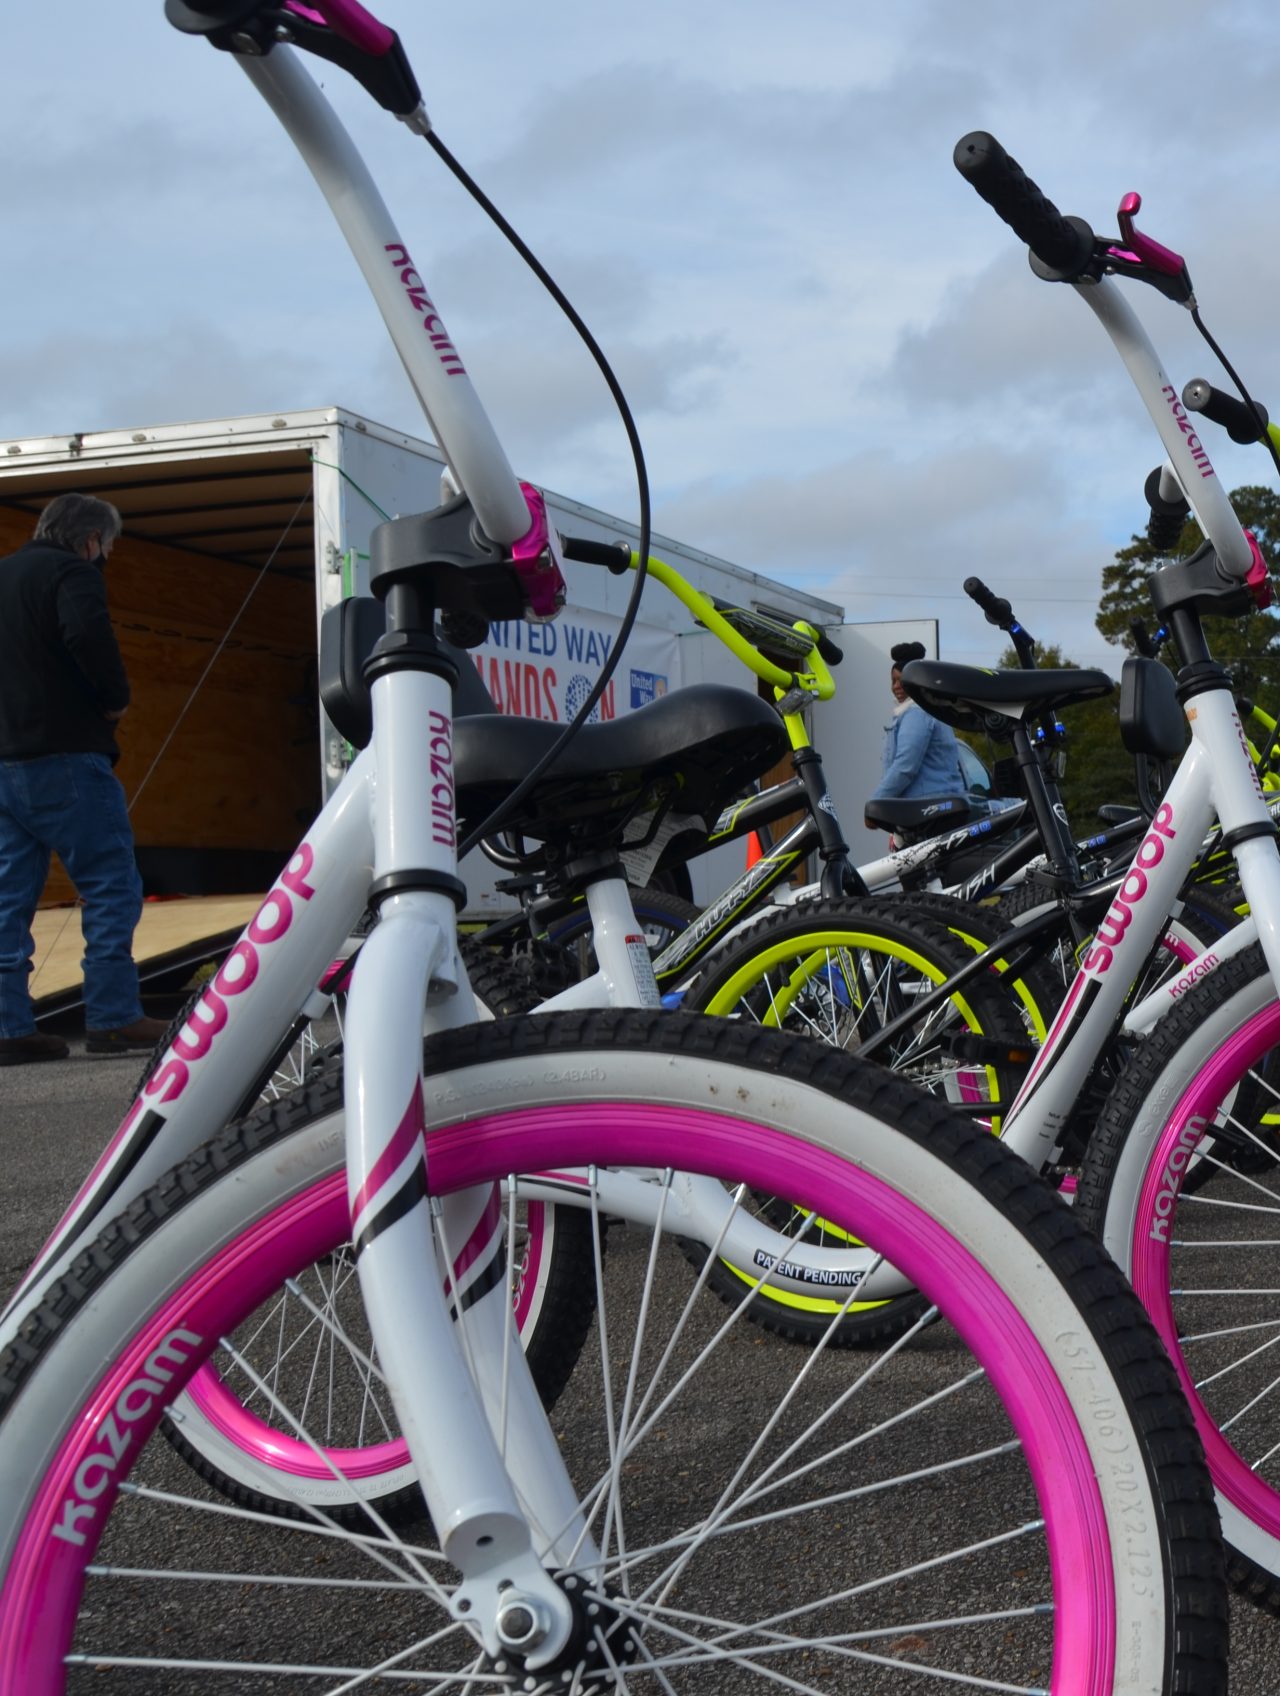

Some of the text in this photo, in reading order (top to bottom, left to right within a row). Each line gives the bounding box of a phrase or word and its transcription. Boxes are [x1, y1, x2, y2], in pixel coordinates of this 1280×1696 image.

[485, 619, 612, 668] NITED WAY
[632, 673, 653, 691] United
[428, 710, 456, 848] kazam
[1084, 802, 1177, 975] swoop
[145, 842, 317, 1105] swoop
[1168, 953, 1219, 999] kazam
[1149, 1112, 1208, 1244] kazam
[756, 1251, 862, 1286] PATENT PENDING
[51, 1326, 204, 1546] kazam
